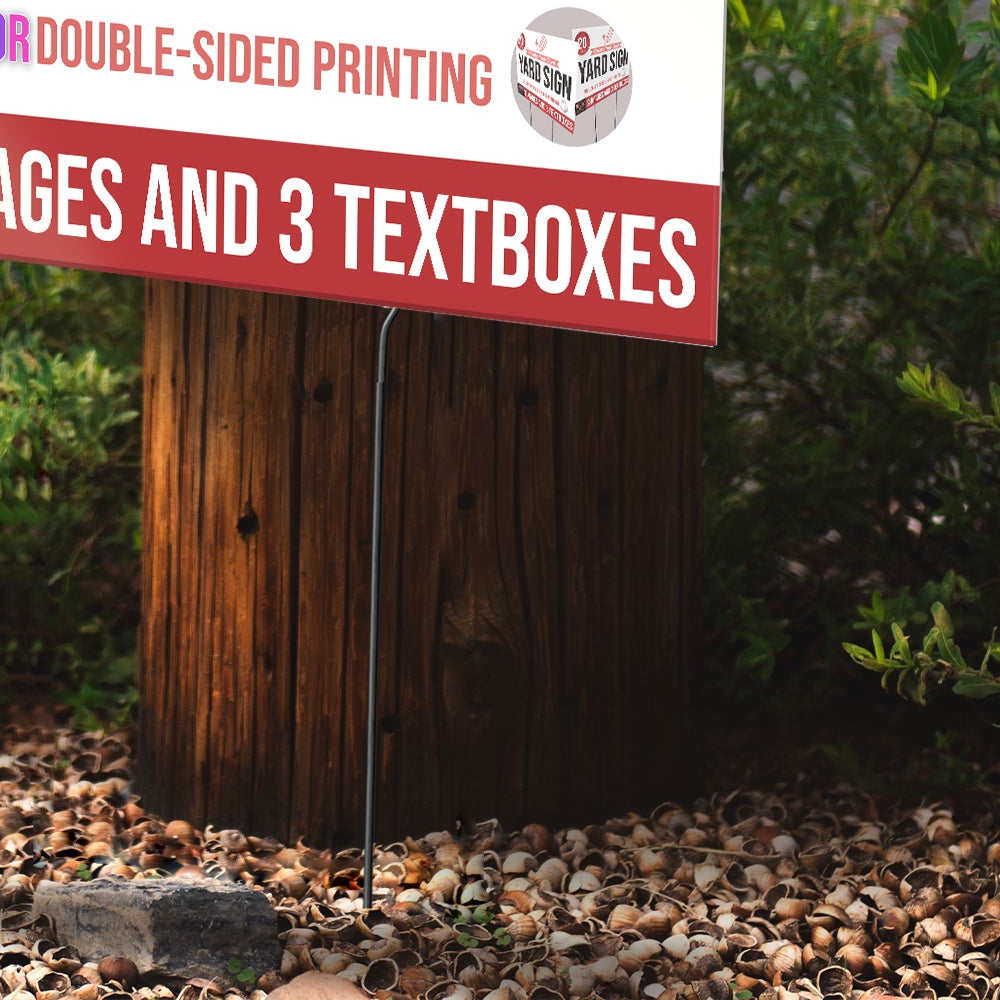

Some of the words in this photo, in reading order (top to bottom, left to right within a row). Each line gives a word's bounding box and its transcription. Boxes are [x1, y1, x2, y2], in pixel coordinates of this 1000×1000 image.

[36, 16, 299, 90] DOUBLE-SIDED
[313, 36, 493, 106] PRINTING
[518, 53, 541, 83] YARD
[543, 65, 573, 101] SIGN
[578, 53, 608, 84] YARD
[609, 48, 629, 72] SIGN
[140, 163, 259, 257] AND
[279, 177, 314, 265] 3
[333, 183, 698, 310] TEXTBOXES
